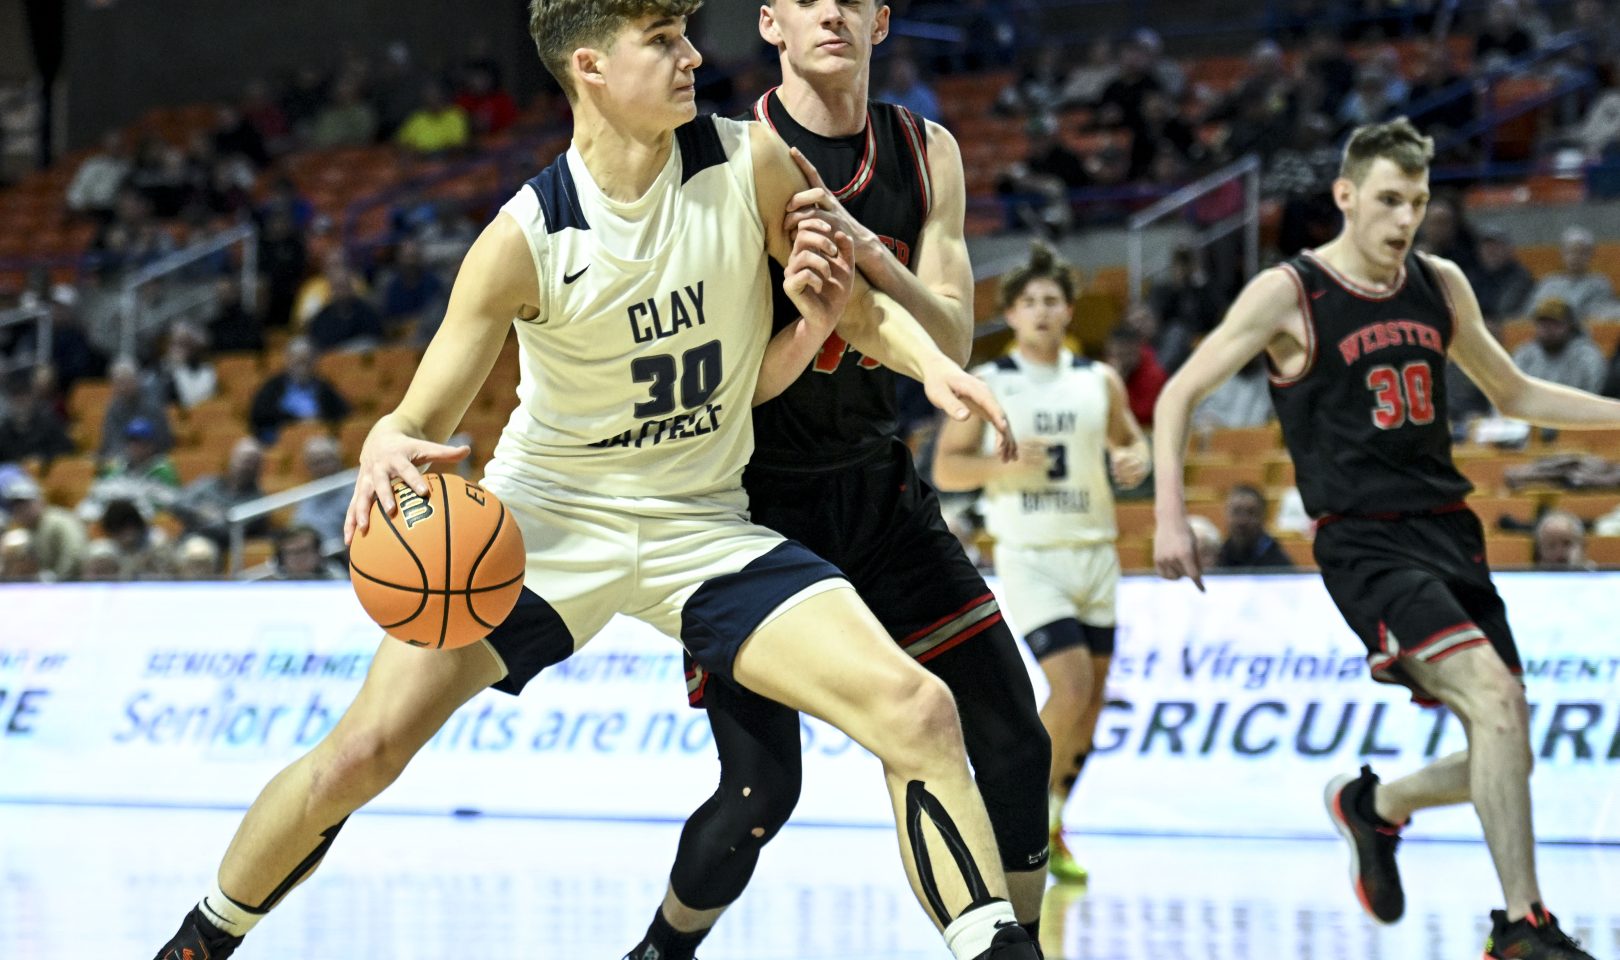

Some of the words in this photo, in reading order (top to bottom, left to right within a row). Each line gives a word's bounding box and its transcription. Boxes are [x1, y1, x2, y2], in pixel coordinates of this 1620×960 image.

[627, 280, 706, 344] CLAY
[1338, 319, 1444, 366] WEBSTER
[630, 339, 723, 419] 30
[1366, 360, 1435, 430] 30
[1034, 411, 1077, 433] CLAY
[1180, 642, 1366, 690] Virginia
[111, 688, 289, 745] Senior
[531, 710, 627, 752] are
[638, 711, 714, 753] no
